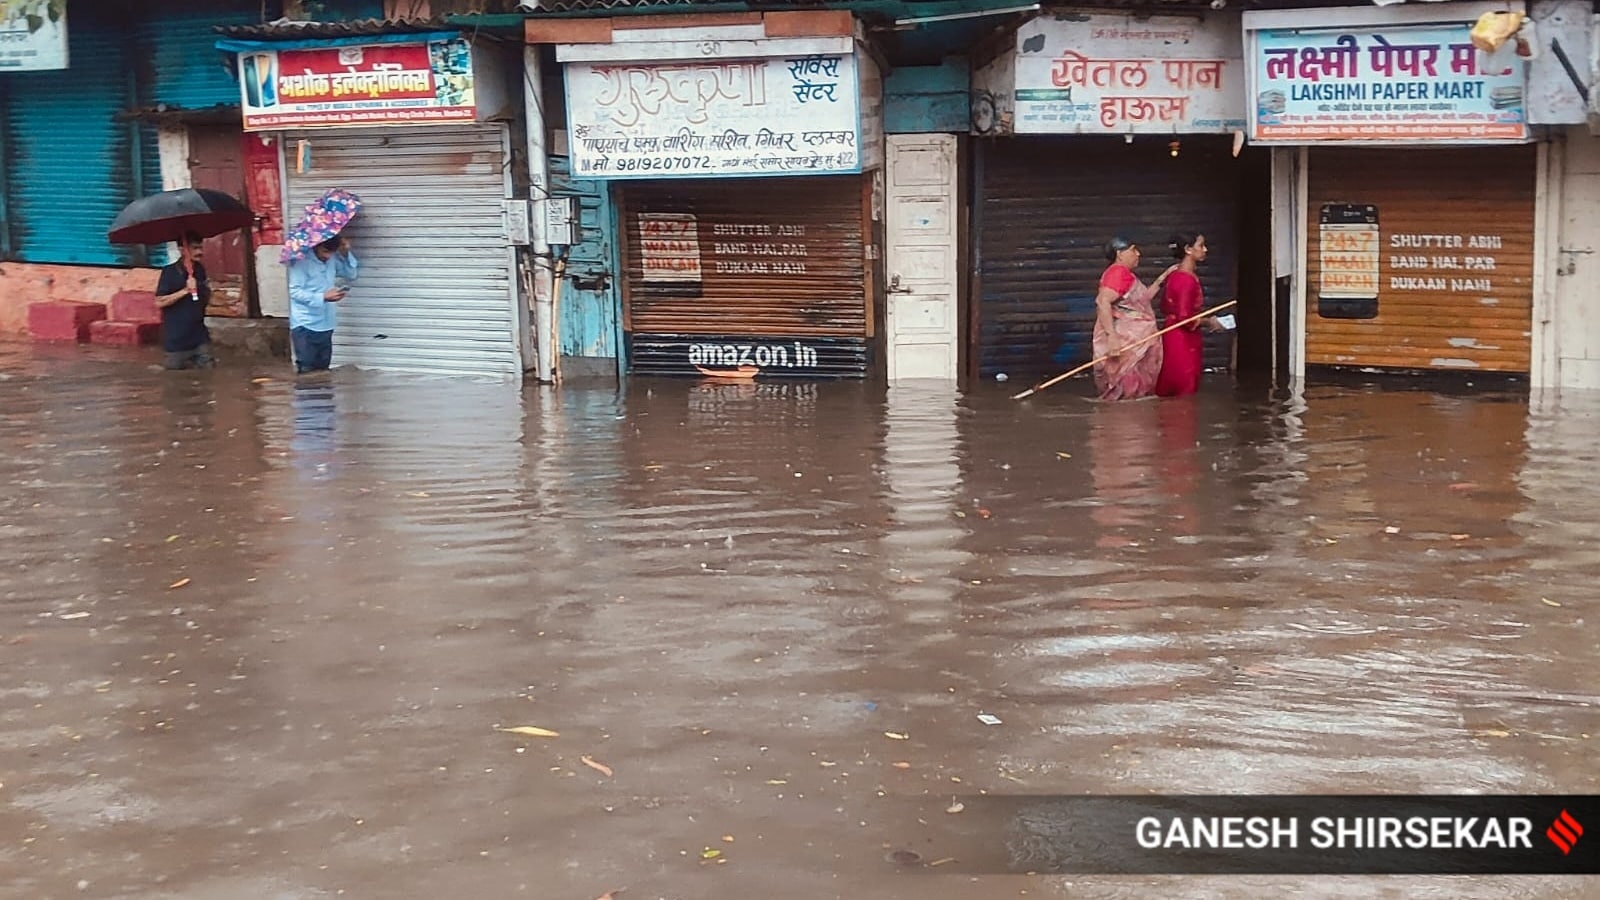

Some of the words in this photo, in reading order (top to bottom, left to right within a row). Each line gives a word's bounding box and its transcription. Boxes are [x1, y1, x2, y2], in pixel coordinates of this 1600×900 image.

[1263, 35, 1361, 81] लक्ष्मी
[1368, 34, 1441, 77] पेपर
[279, 67, 329, 98] अशोक
[329, 62, 430, 98] इलेक्ट्रॉनिक्स
[1162, 59, 1227, 89] पान
[792, 79, 838, 103] सेंटर
[1291, 83, 1367, 101] LAKSHMI
[1372, 82, 1429, 100] PAPER
[1434, 81, 1485, 99] MART
[1100, 96, 1190, 128] हाऊस
[663, 126, 706, 152] वाशिंग
[754, 128, 798, 152] गिजर
[801, 130, 855, 147] प्लम्बर
[713, 224, 772, 236] SHUTTER
[777, 224, 806, 236] ABHI
[714, 243, 749, 255] BAND
[782, 244, 808, 257] PAR
[1390, 234, 1463, 249] SHUTTER
[1467, 235, 1502, 249] ABHI
[715, 261, 769, 274] DUKAAN
[772, 261, 806, 275] NAHI
[1390, 255, 1428, 270] BAND
[1465, 256, 1496, 270] PAR
[1390, 276, 1447, 290] DUKAAN
[1451, 278, 1492, 292] NAHI
[688, 341, 818, 367] amazon.in
